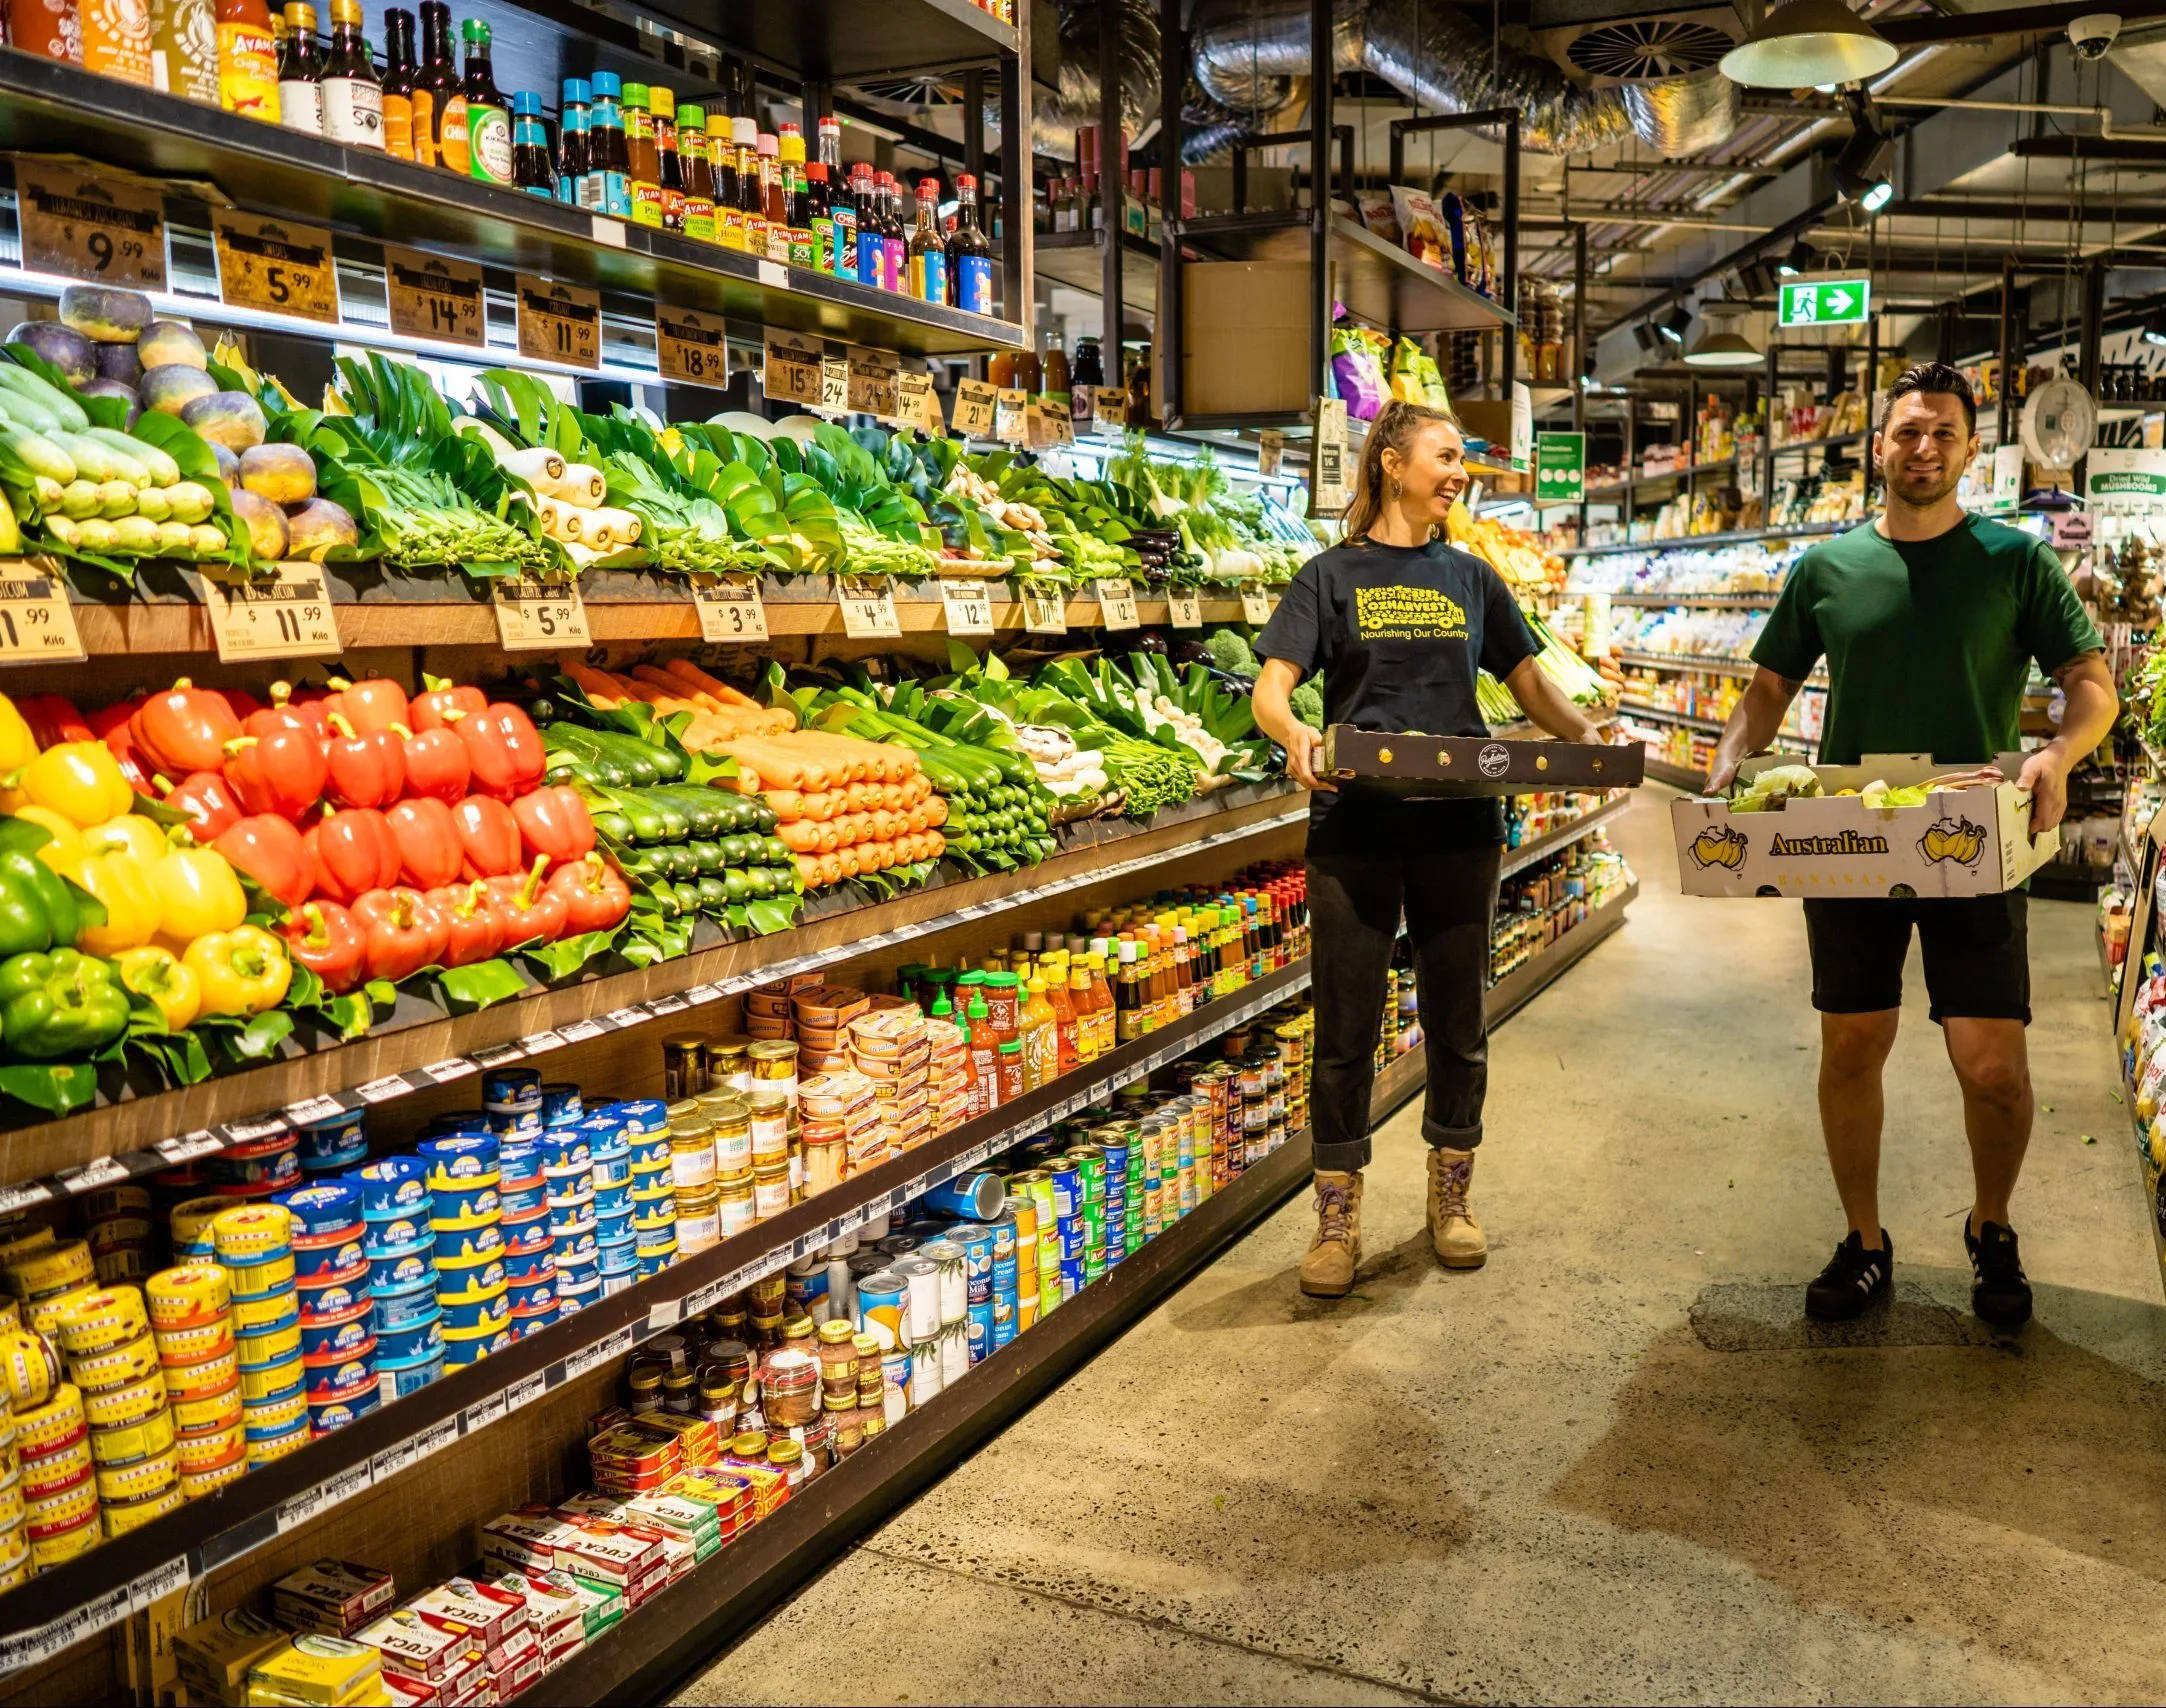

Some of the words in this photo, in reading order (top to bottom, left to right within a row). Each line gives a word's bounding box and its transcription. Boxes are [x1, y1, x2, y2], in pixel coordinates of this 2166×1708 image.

[793, 249, 811, 259] SOY
[2100, 481, 2157, 493] MUSHROOMS
[1367, 600, 1447, 612] OZHARVEST
[43, 634, 65, 647] Kilo
[312, 631, 328, 641] Kilo
[1360, 628, 1412, 641] Nourishing
[1413, 628, 1431, 639] Our
[1433, 628, 1469, 641] Country
[1769, 829, 1890, 857] Australian
[1777, 874, 1888, 887] BANANAS
[969, 1285, 987, 1293] Milk
[655, 1506, 695, 1520] CUCA
[513, 1524, 557, 1542] CUCA
[584, 1542, 632, 1559] CUCA
[441, 1605, 491, 1624] CUCA
[541, 1609, 561, 1626] CUCA
[383, 1635, 433, 1656] CUCA
